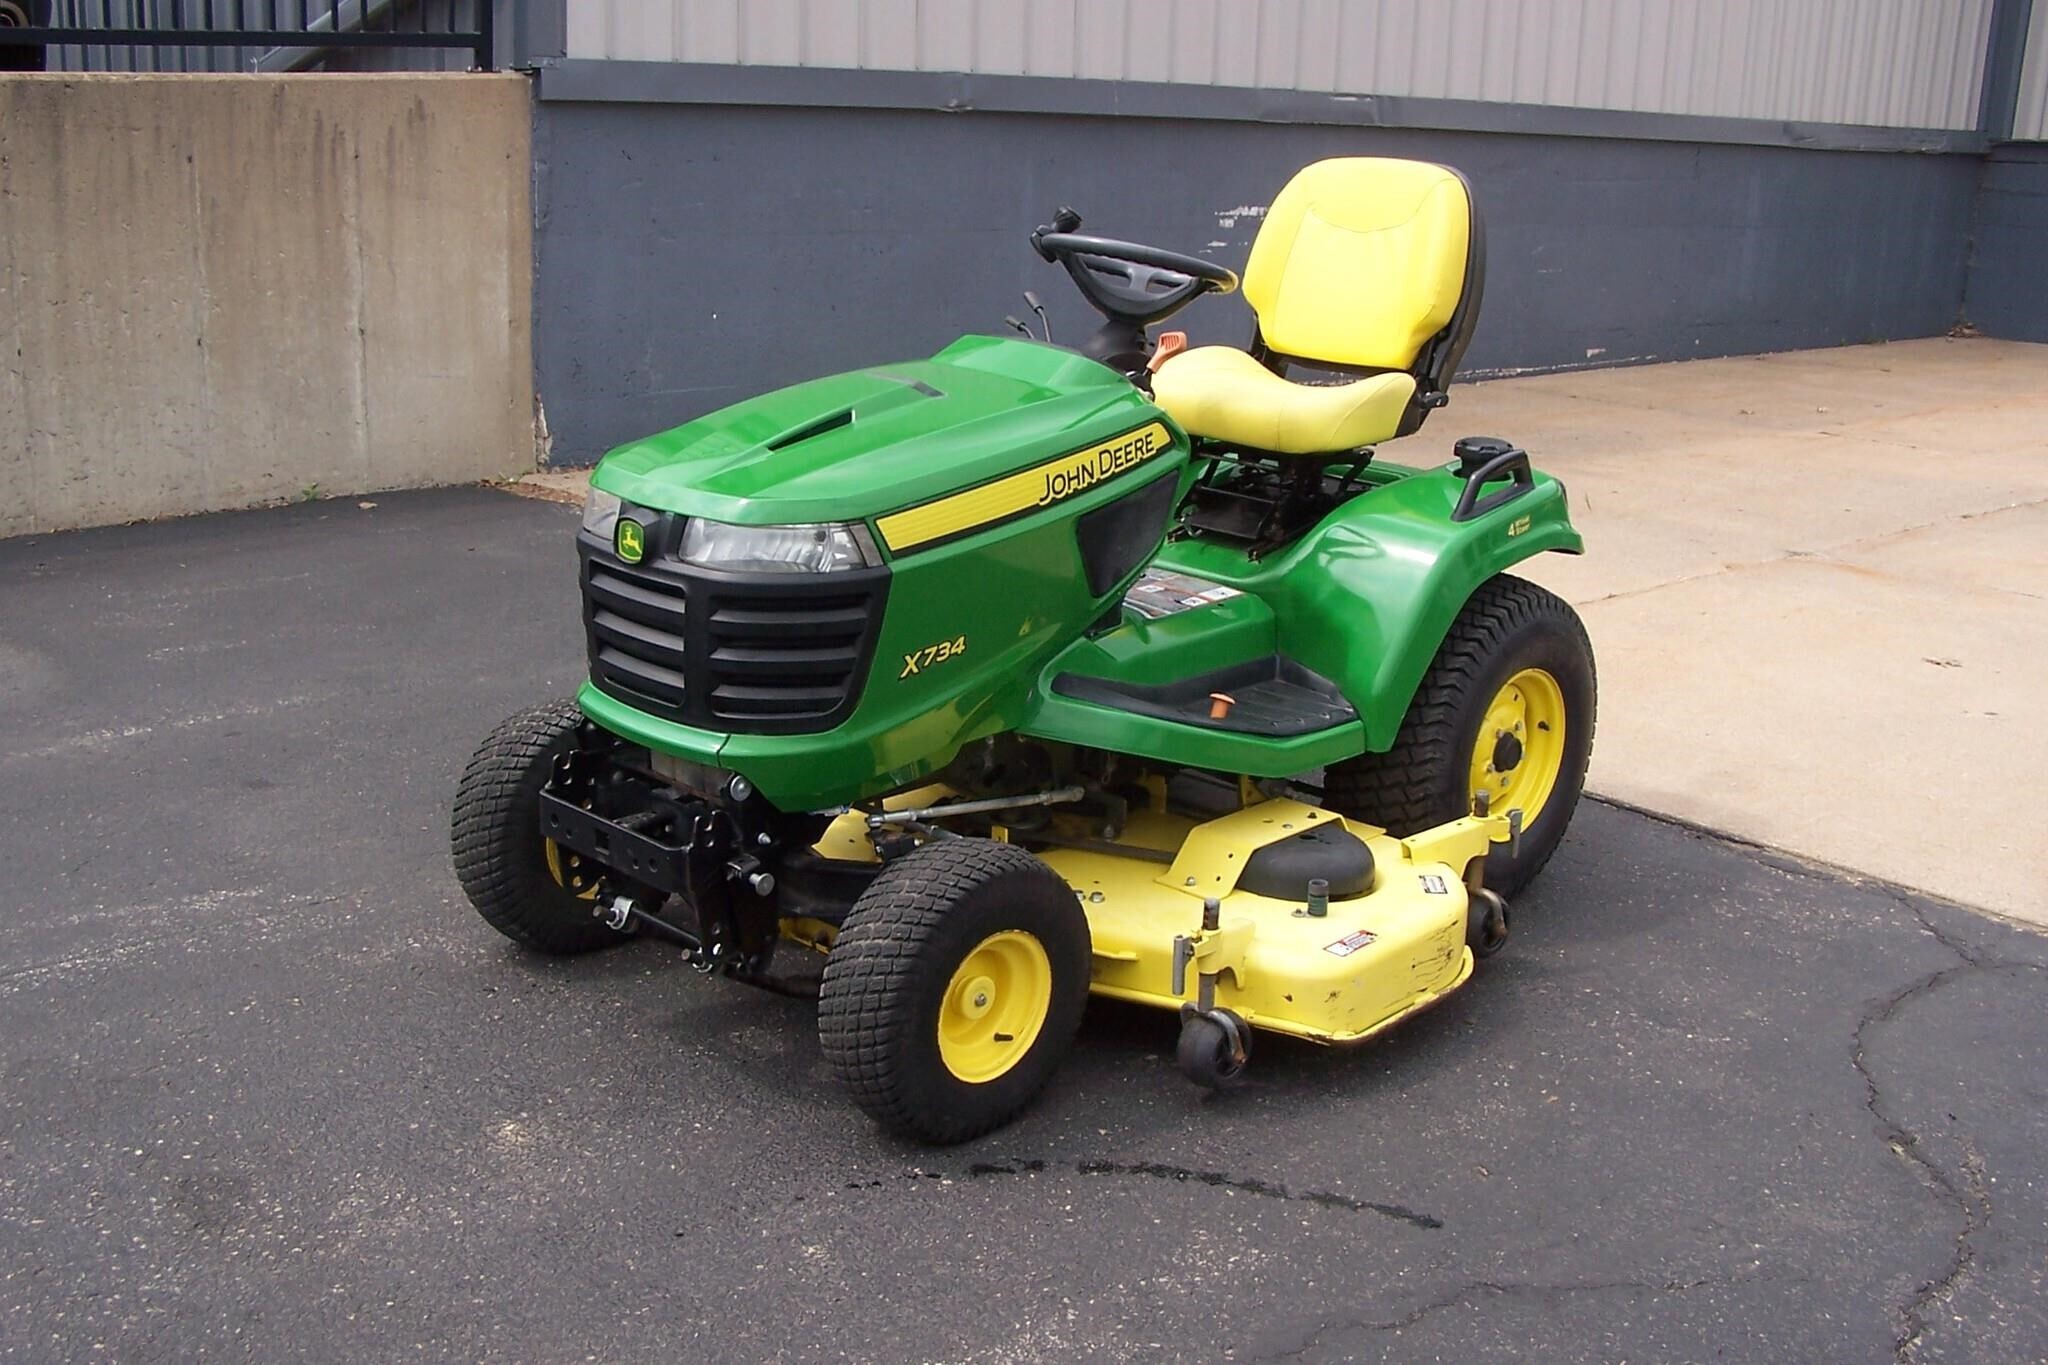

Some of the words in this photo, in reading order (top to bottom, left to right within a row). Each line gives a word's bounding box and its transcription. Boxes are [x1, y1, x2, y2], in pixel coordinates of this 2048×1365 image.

[1039, 459, 1095, 502] JOHN
[1099, 432, 1155, 476] DEERE
[899, 635, 966, 680] X734
